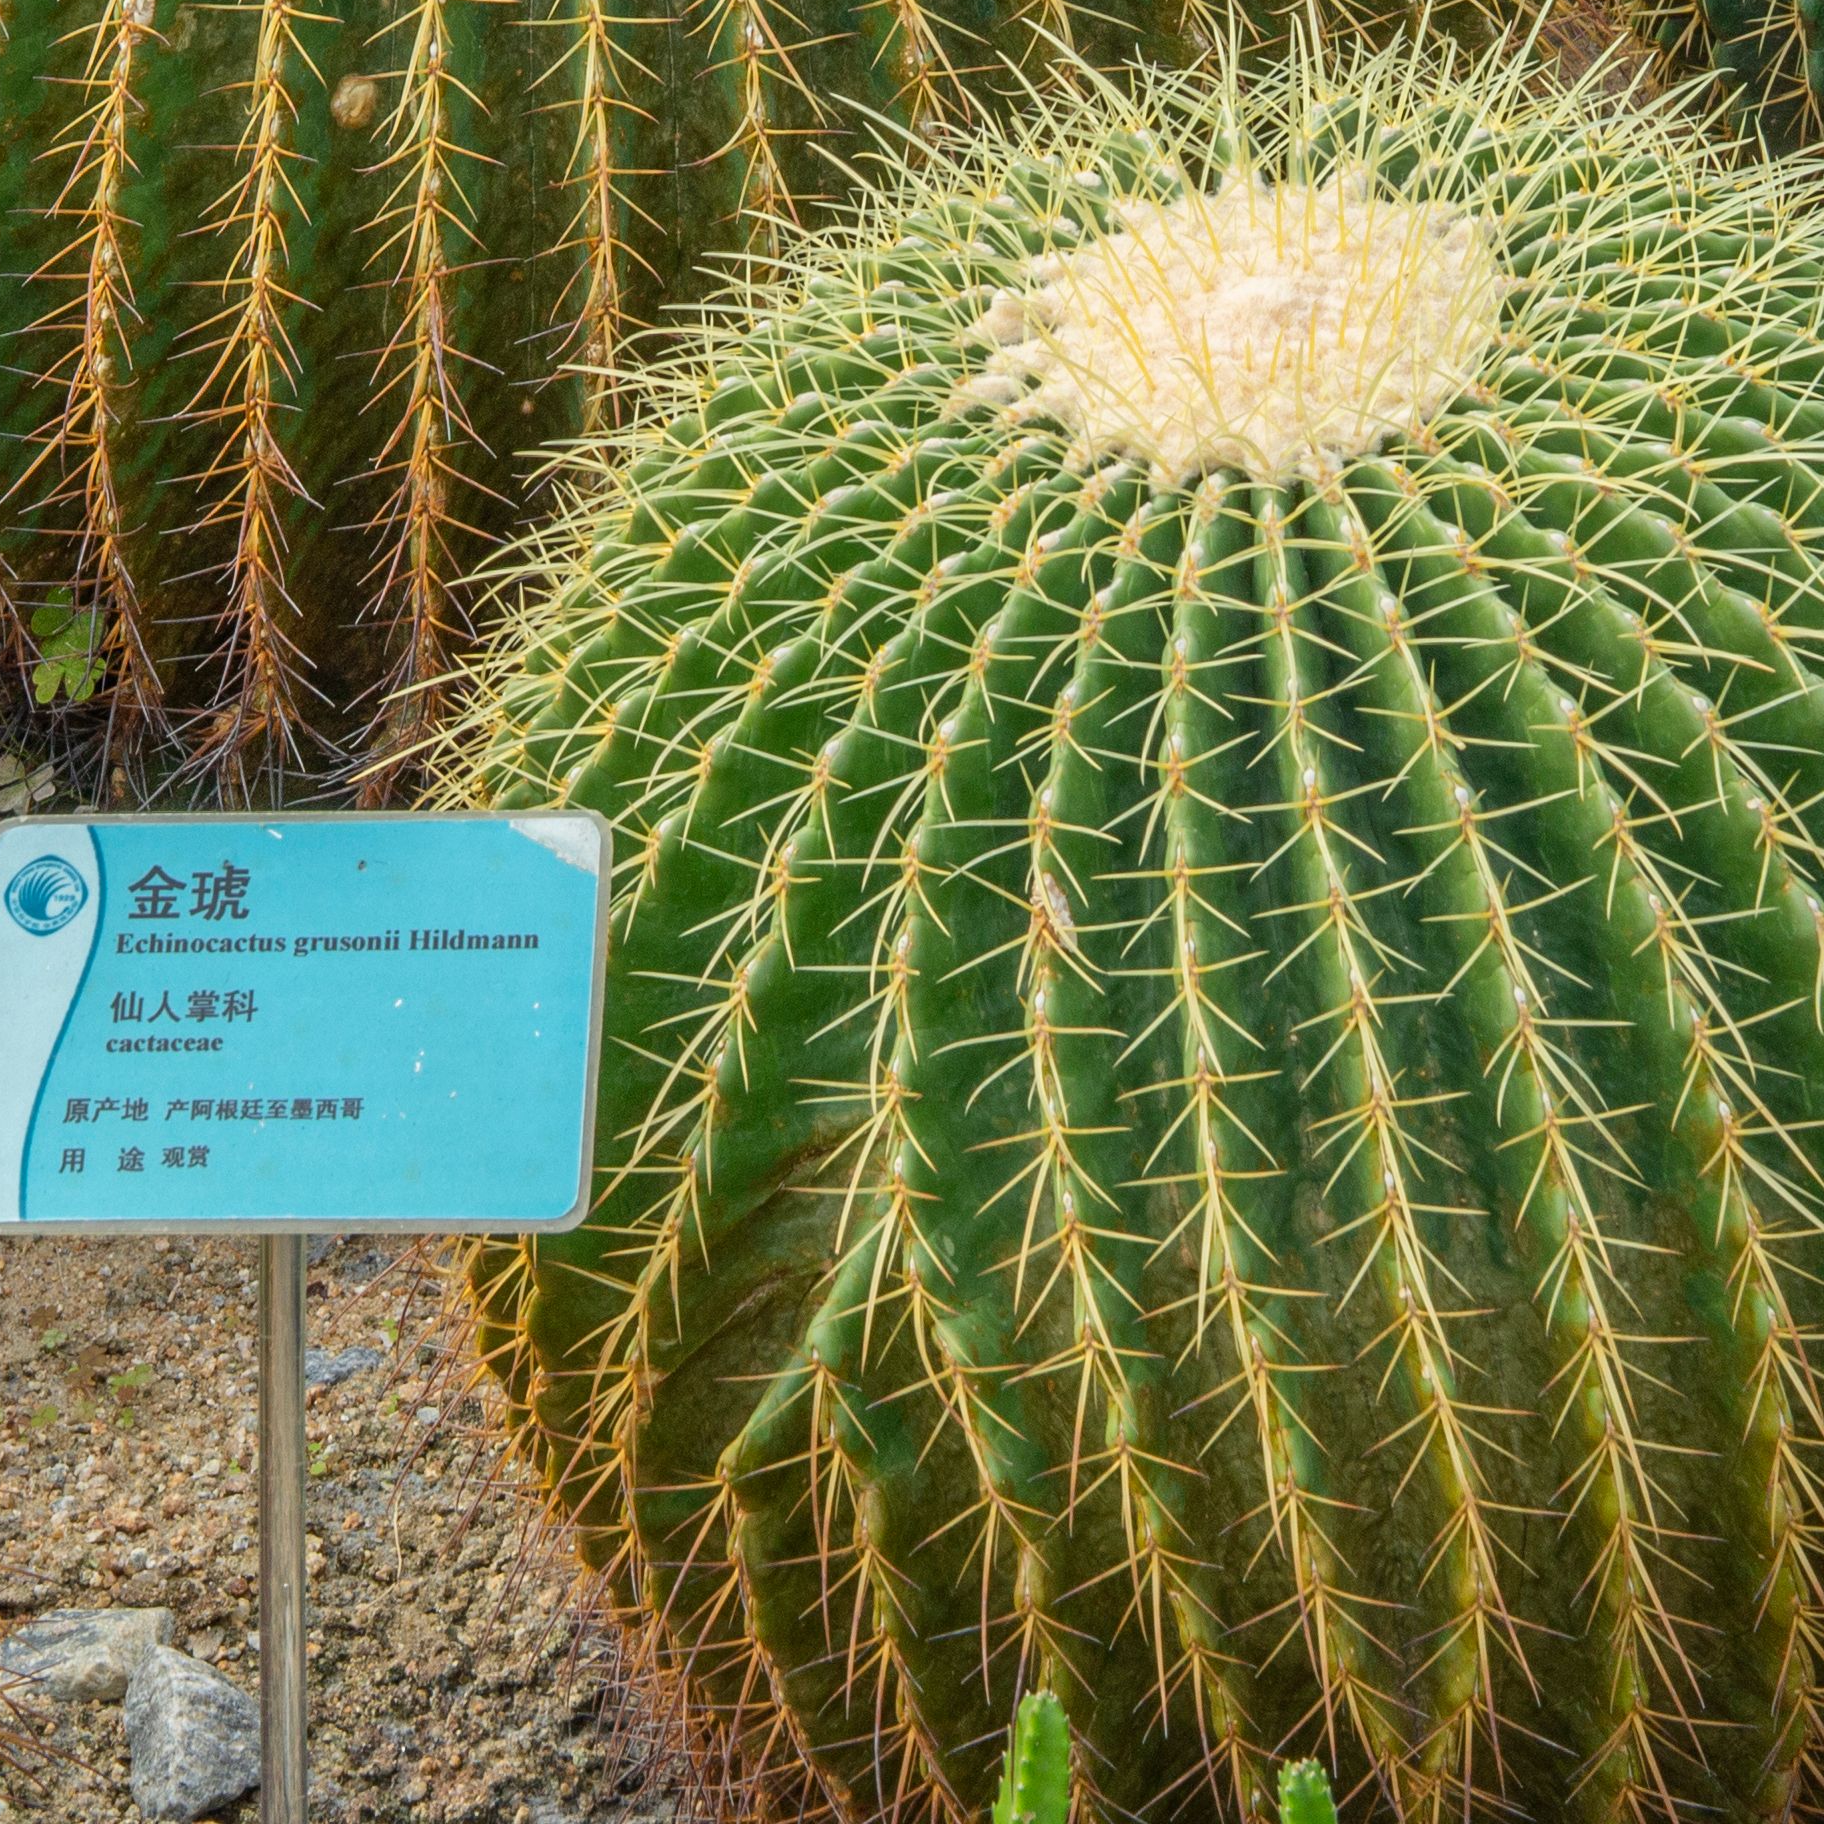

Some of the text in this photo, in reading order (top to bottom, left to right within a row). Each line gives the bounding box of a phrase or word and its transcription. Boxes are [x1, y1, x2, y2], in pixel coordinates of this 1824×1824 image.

[128, 864, 251, 922] 金琥
[116, 929, 539, 957] Echinocactus grusonii Hildmann
[110, 990, 258, 1024] 仙人掌科
[106, 1035, 223, 1053] cactaceae
[63, 1098, 364, 1125] 原产地 产阿根廷至墨西哥
[161, 1146, 211, 1169] 观赏
